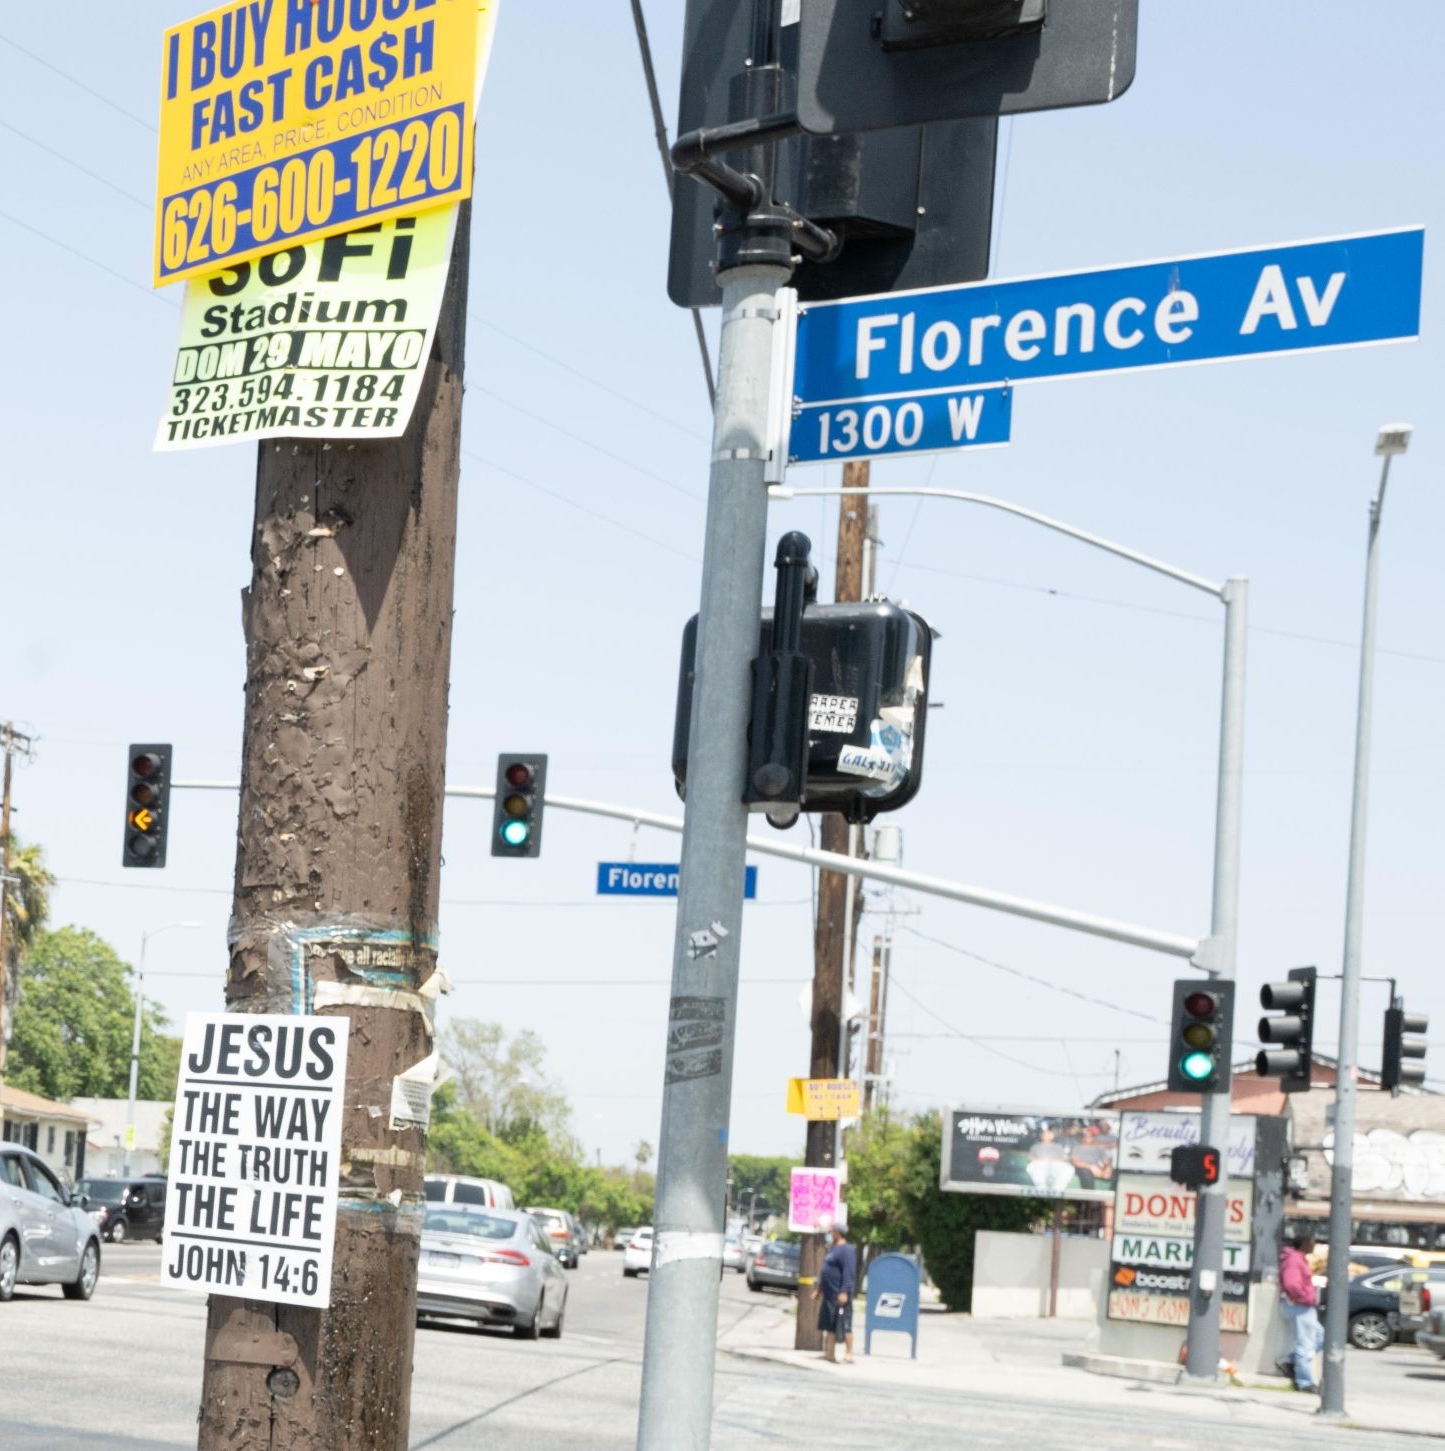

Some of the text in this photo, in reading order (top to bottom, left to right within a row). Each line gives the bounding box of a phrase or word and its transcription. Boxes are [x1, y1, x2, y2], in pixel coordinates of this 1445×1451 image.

[167, 33, 180, 100] I
[191, 0, 274, 91] BUY
[191, 19, 435, 151] FAST CA$H
[181, 156, 215, 184] ANY
[217, 143, 268, 174] AREA,
[337, 82, 443, 133] CONDITION
[162, 110, 461, 270] 626-600-1220
[200, 292, 408, 338] Stadium
[855, 264, 1347, 379] Florence Av
[174, 331, 425, 384] DOM 29 MAYO
[172, 374, 406, 417] 323.594.1184
[168, 406, 399, 442] TICKETMASTER
[818, 394, 985, 454] 1300 W
[608, 867, 680, 889] Floren
[356, 945, 370, 965] all
[188, 1023, 336, 1081] JESUS
[183, 1090, 332, 1143] THE WAY
[178, 1139, 329, 1188] THE TRUTH
[175, 1182, 325, 1241] THE LIFE
[1124, 1192, 1244, 1224] DONS
[169, 1244, 320, 1297] JOHN 14:6
[1122, 1239, 1242, 1266] MART
